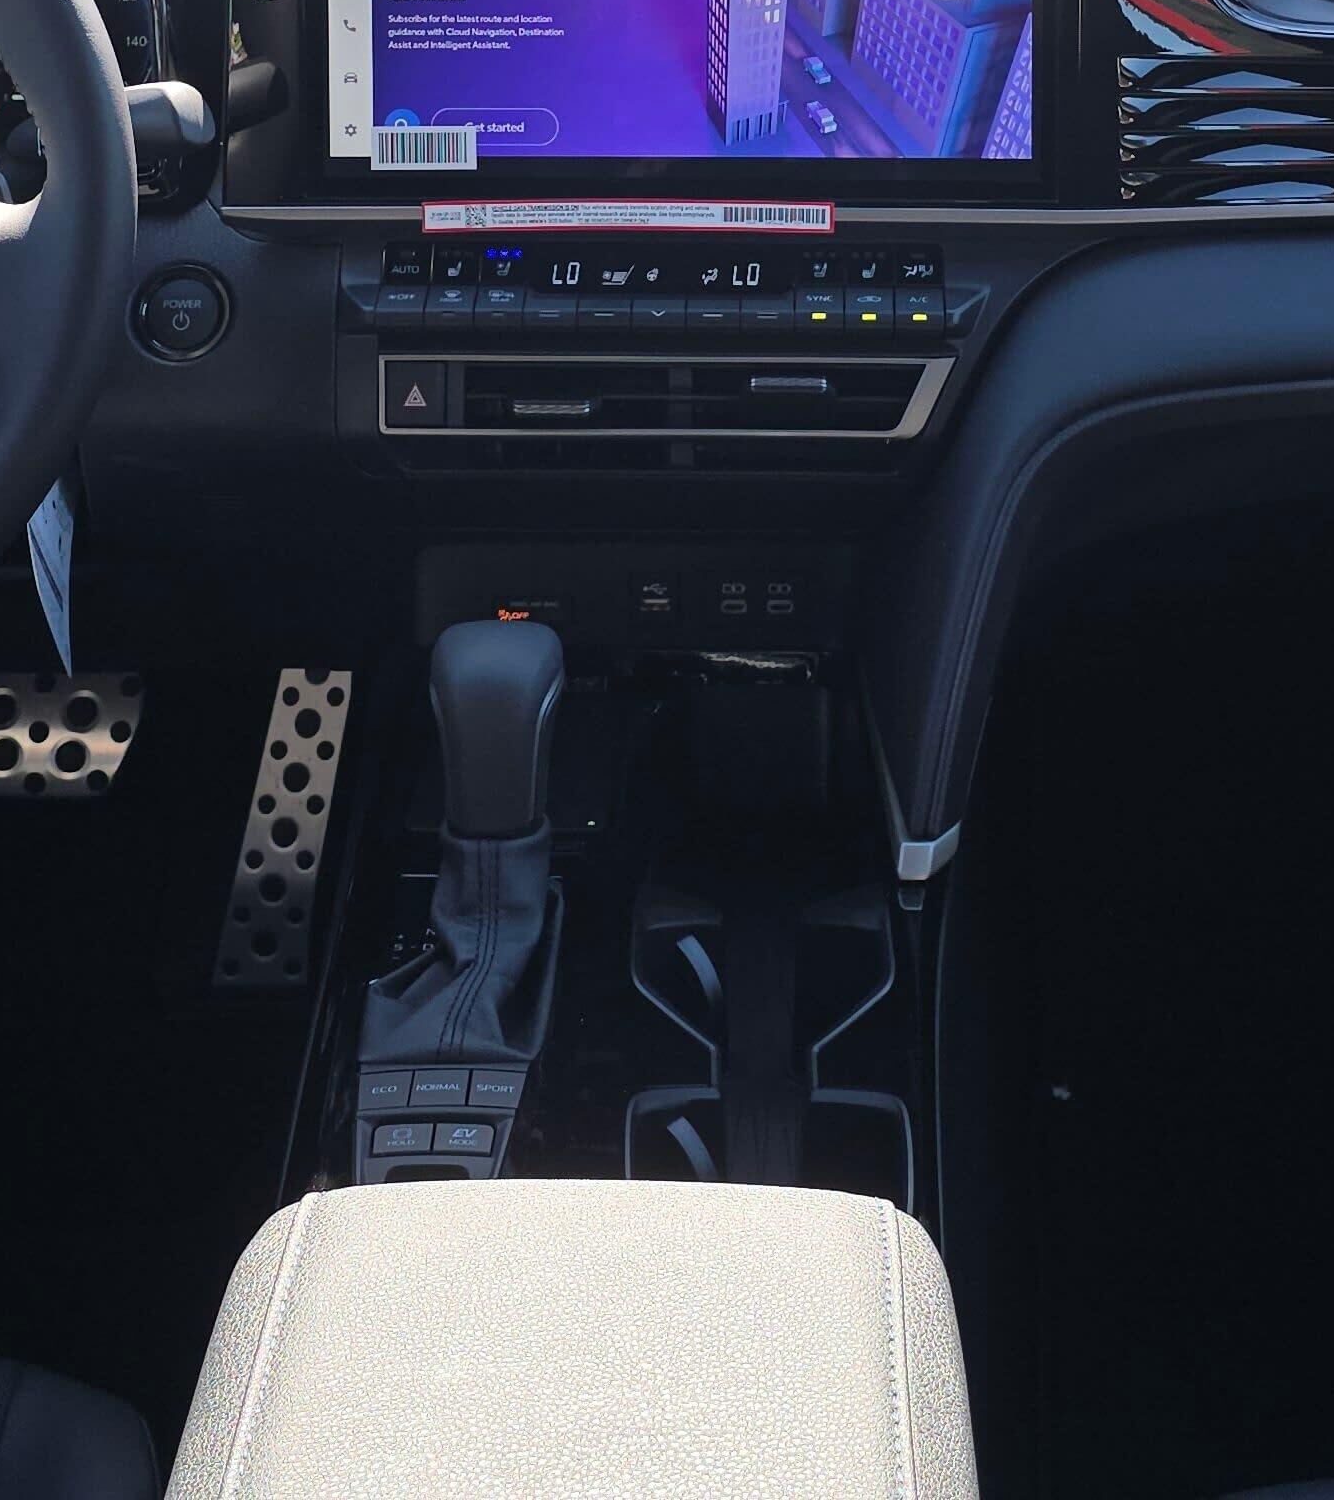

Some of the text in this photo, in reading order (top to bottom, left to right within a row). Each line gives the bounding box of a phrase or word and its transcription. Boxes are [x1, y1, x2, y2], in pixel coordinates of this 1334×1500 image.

[388, 14, 553, 23] Subscribe for the latest route and location
[388, 28, 425, 38] guidance
[427, 28, 444, 36] with
[445, 28, 470, 36] Cloud
[519, 28, 564, 37] Destination
[126, 35, 148, 48] 140
[388, 41, 412, 49] Assist
[413, 41, 429, 49] and
[430, 41, 471, 51] Intelligent
[487, 121, 525, 133] started
[391, 265, 420, 274] AUTO
[552, 262, 580, 285] LO
[732, 263, 760, 286] LO
[806, 294, 834, 303] SYNC
[909, 295, 929, 304] A/C
[163, 299, 203, 309] POWER
[371, 1085, 397, 1095] ECO
[416, 1083, 461, 1092] NORMAL
[476, 1084, 515, 1094] SPORT
[451, 1128, 478, 1138] EV
[386, 1138, 415, 1147] HOLD
